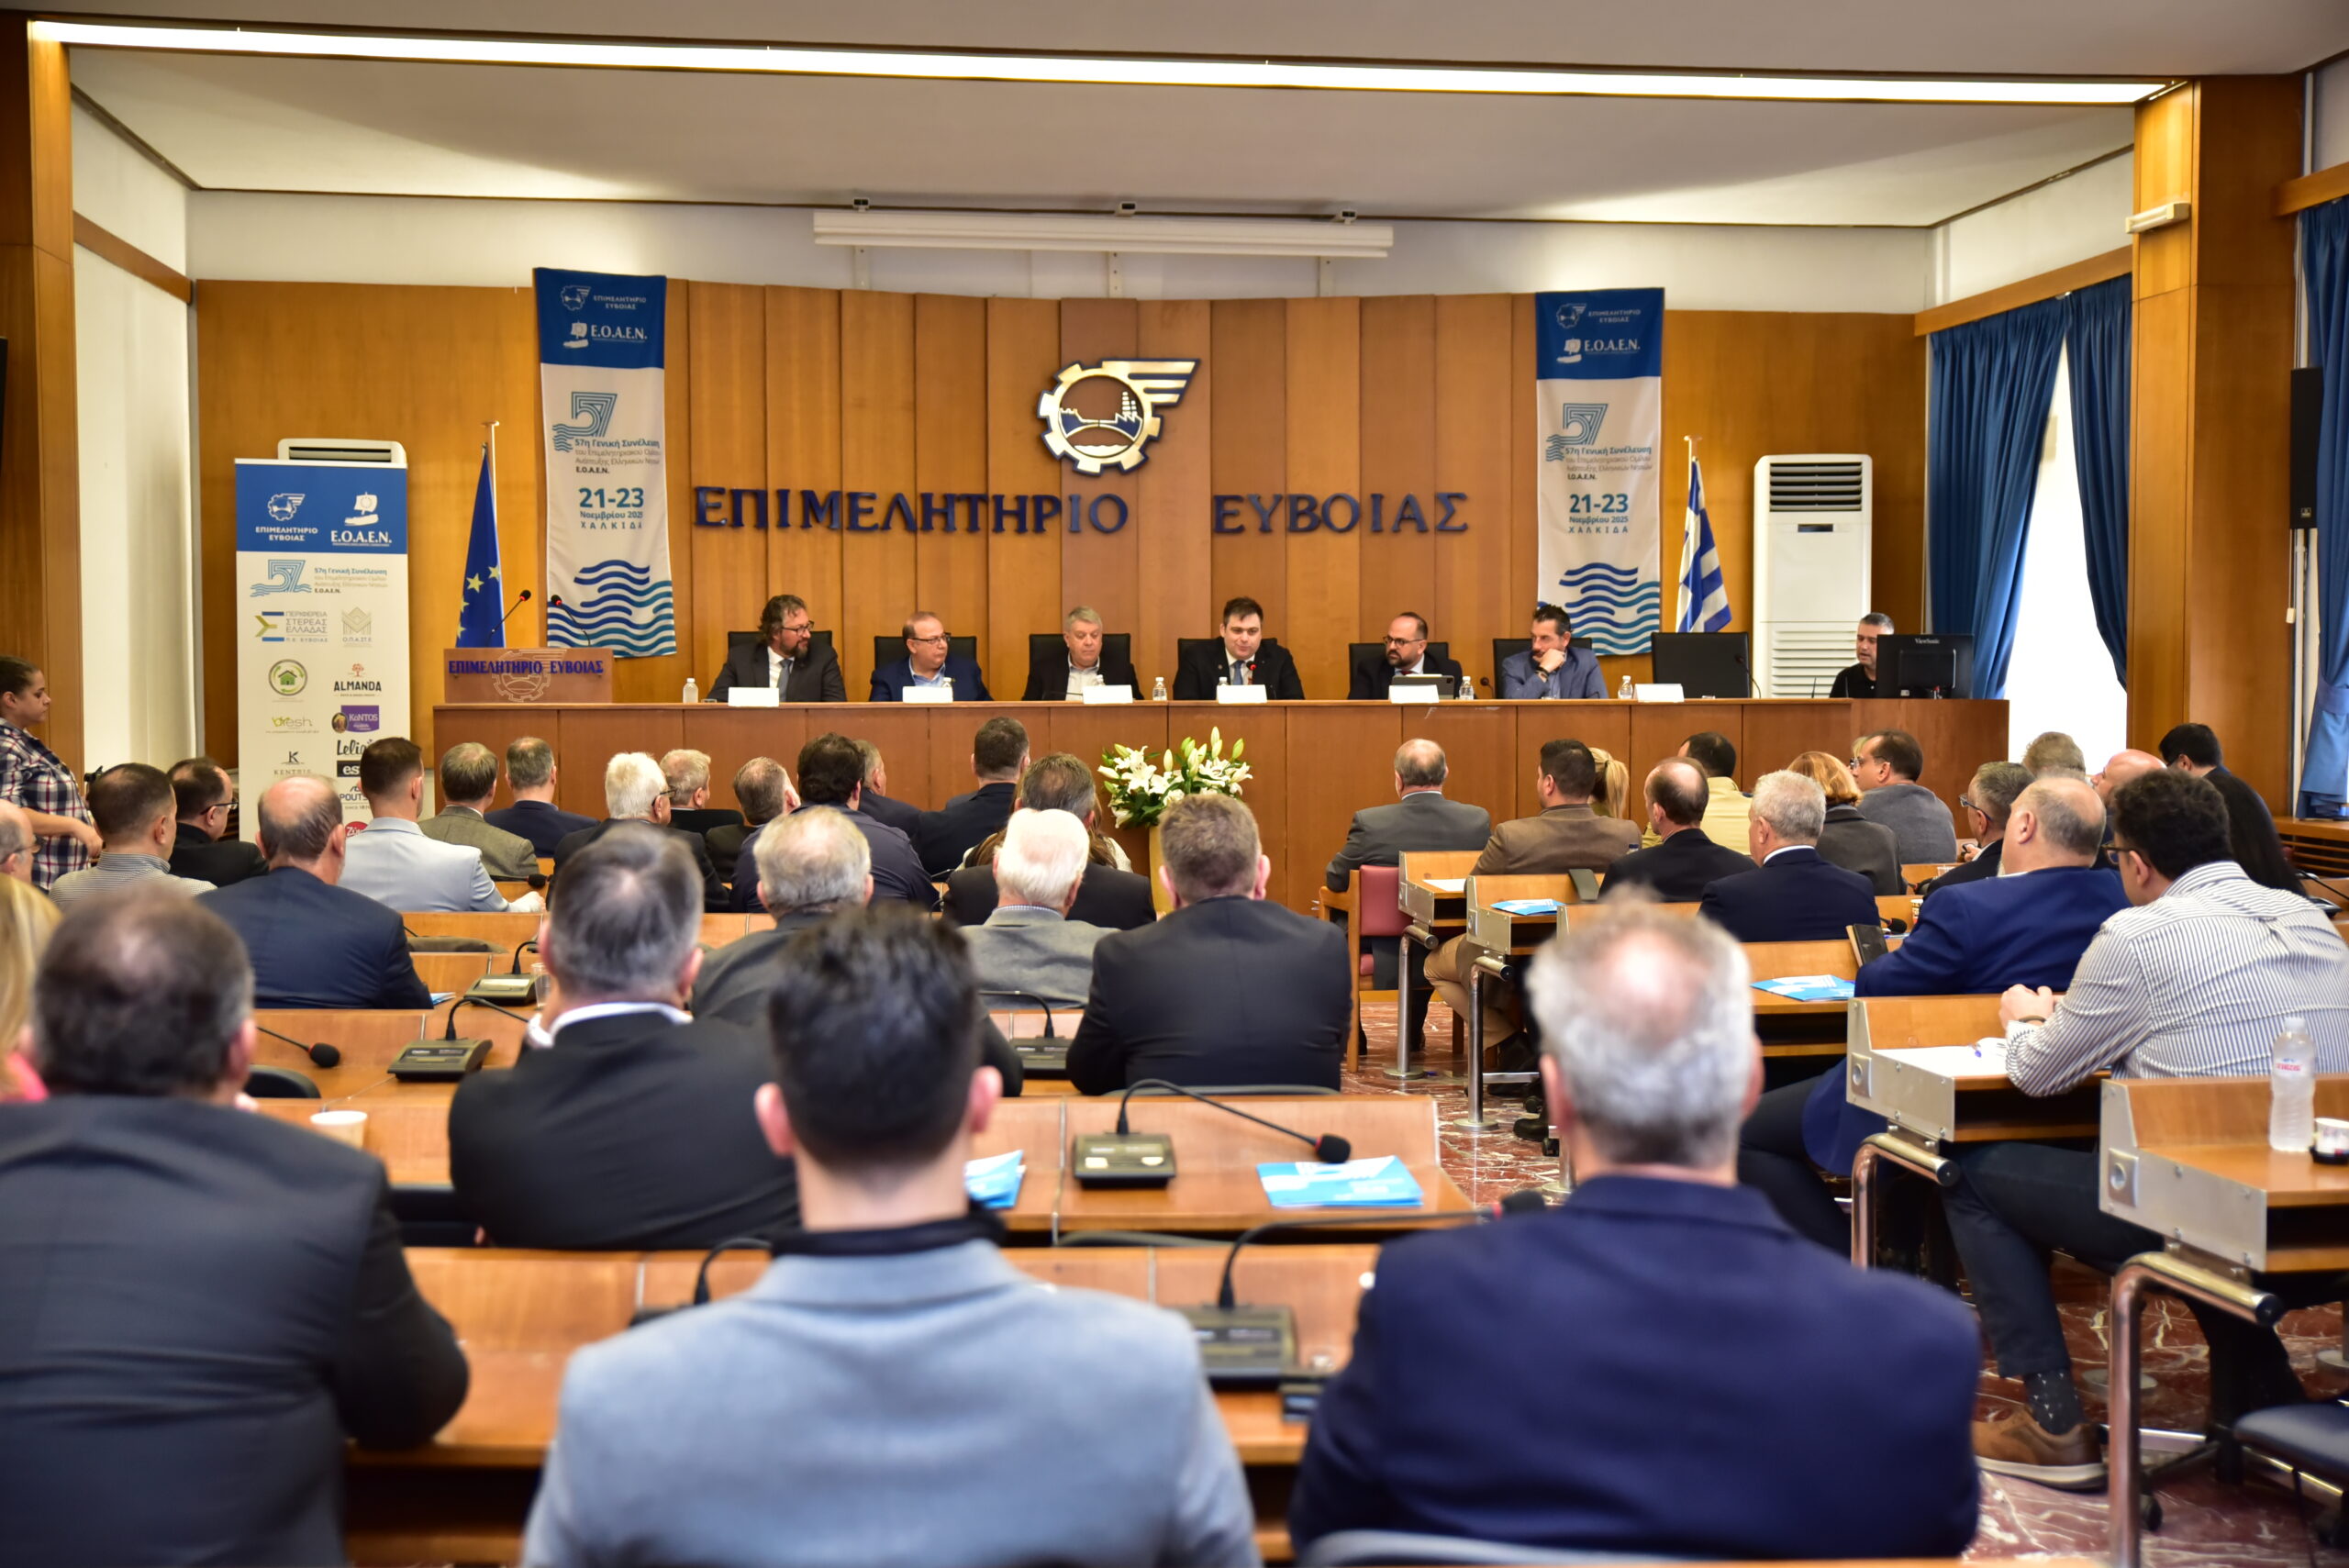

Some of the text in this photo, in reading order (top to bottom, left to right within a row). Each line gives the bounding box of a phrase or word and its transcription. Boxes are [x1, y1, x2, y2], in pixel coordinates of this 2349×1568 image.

[578, 487, 644, 508] 21-23
[1569, 494, 1629, 514] 21-23
[580, 510, 626, 520] Νοεμβρίου
[693, 485, 1469, 536] ΕΠΙΜΕΛΗΤΗΡΙΟ ΕΥΒΟΙΑΣ
[255, 526, 318, 534] ΕΠΙΜΕΛΗΤΗΡΙΟ
[330, 530, 393, 543] Ε.Ο.Α.Ε.Ν.
[449, 660, 604, 674] ΕΠΙΜΕΛΗΤΗΡΙΟ ΕΥΒΟΙΑΣ
[333, 681, 382, 692] ALMANDA
